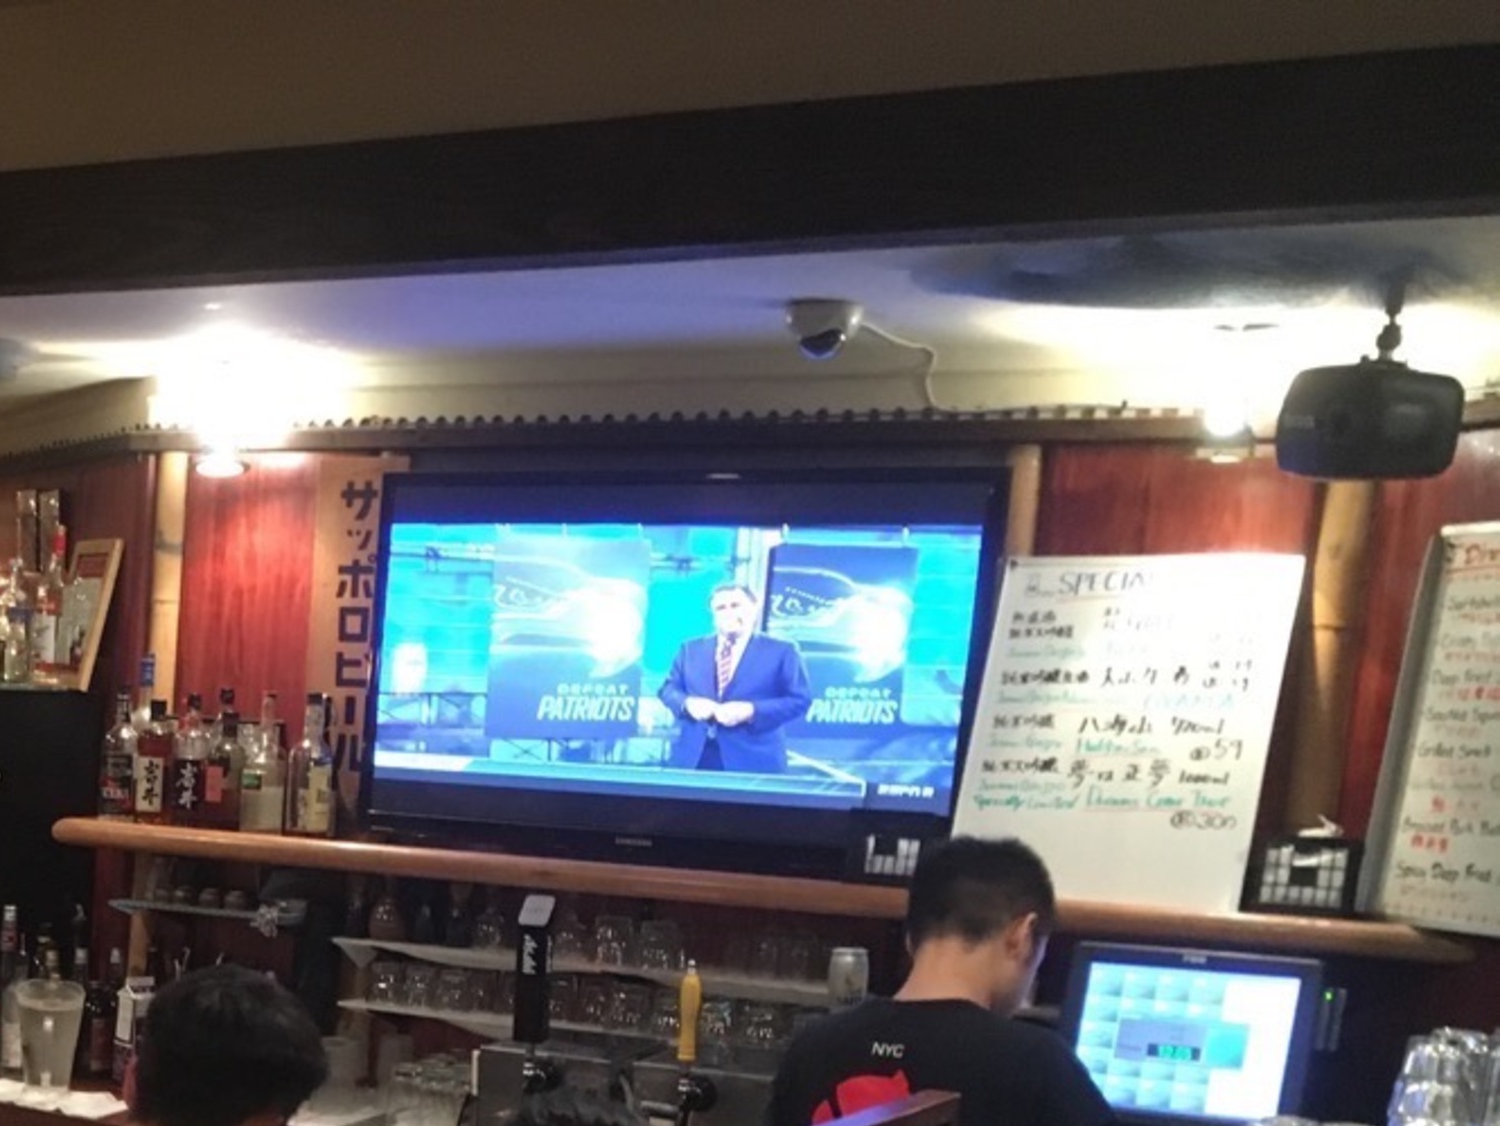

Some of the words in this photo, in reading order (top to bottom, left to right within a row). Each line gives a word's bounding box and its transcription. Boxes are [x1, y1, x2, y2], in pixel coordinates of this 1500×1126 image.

[1058, 571, 1150, 596] SPECIA
[536, 695, 636, 722] PATRIOTS
[806, 698, 899, 724] PATRIOTS
[871, 1041, 905, 1059] NYC
